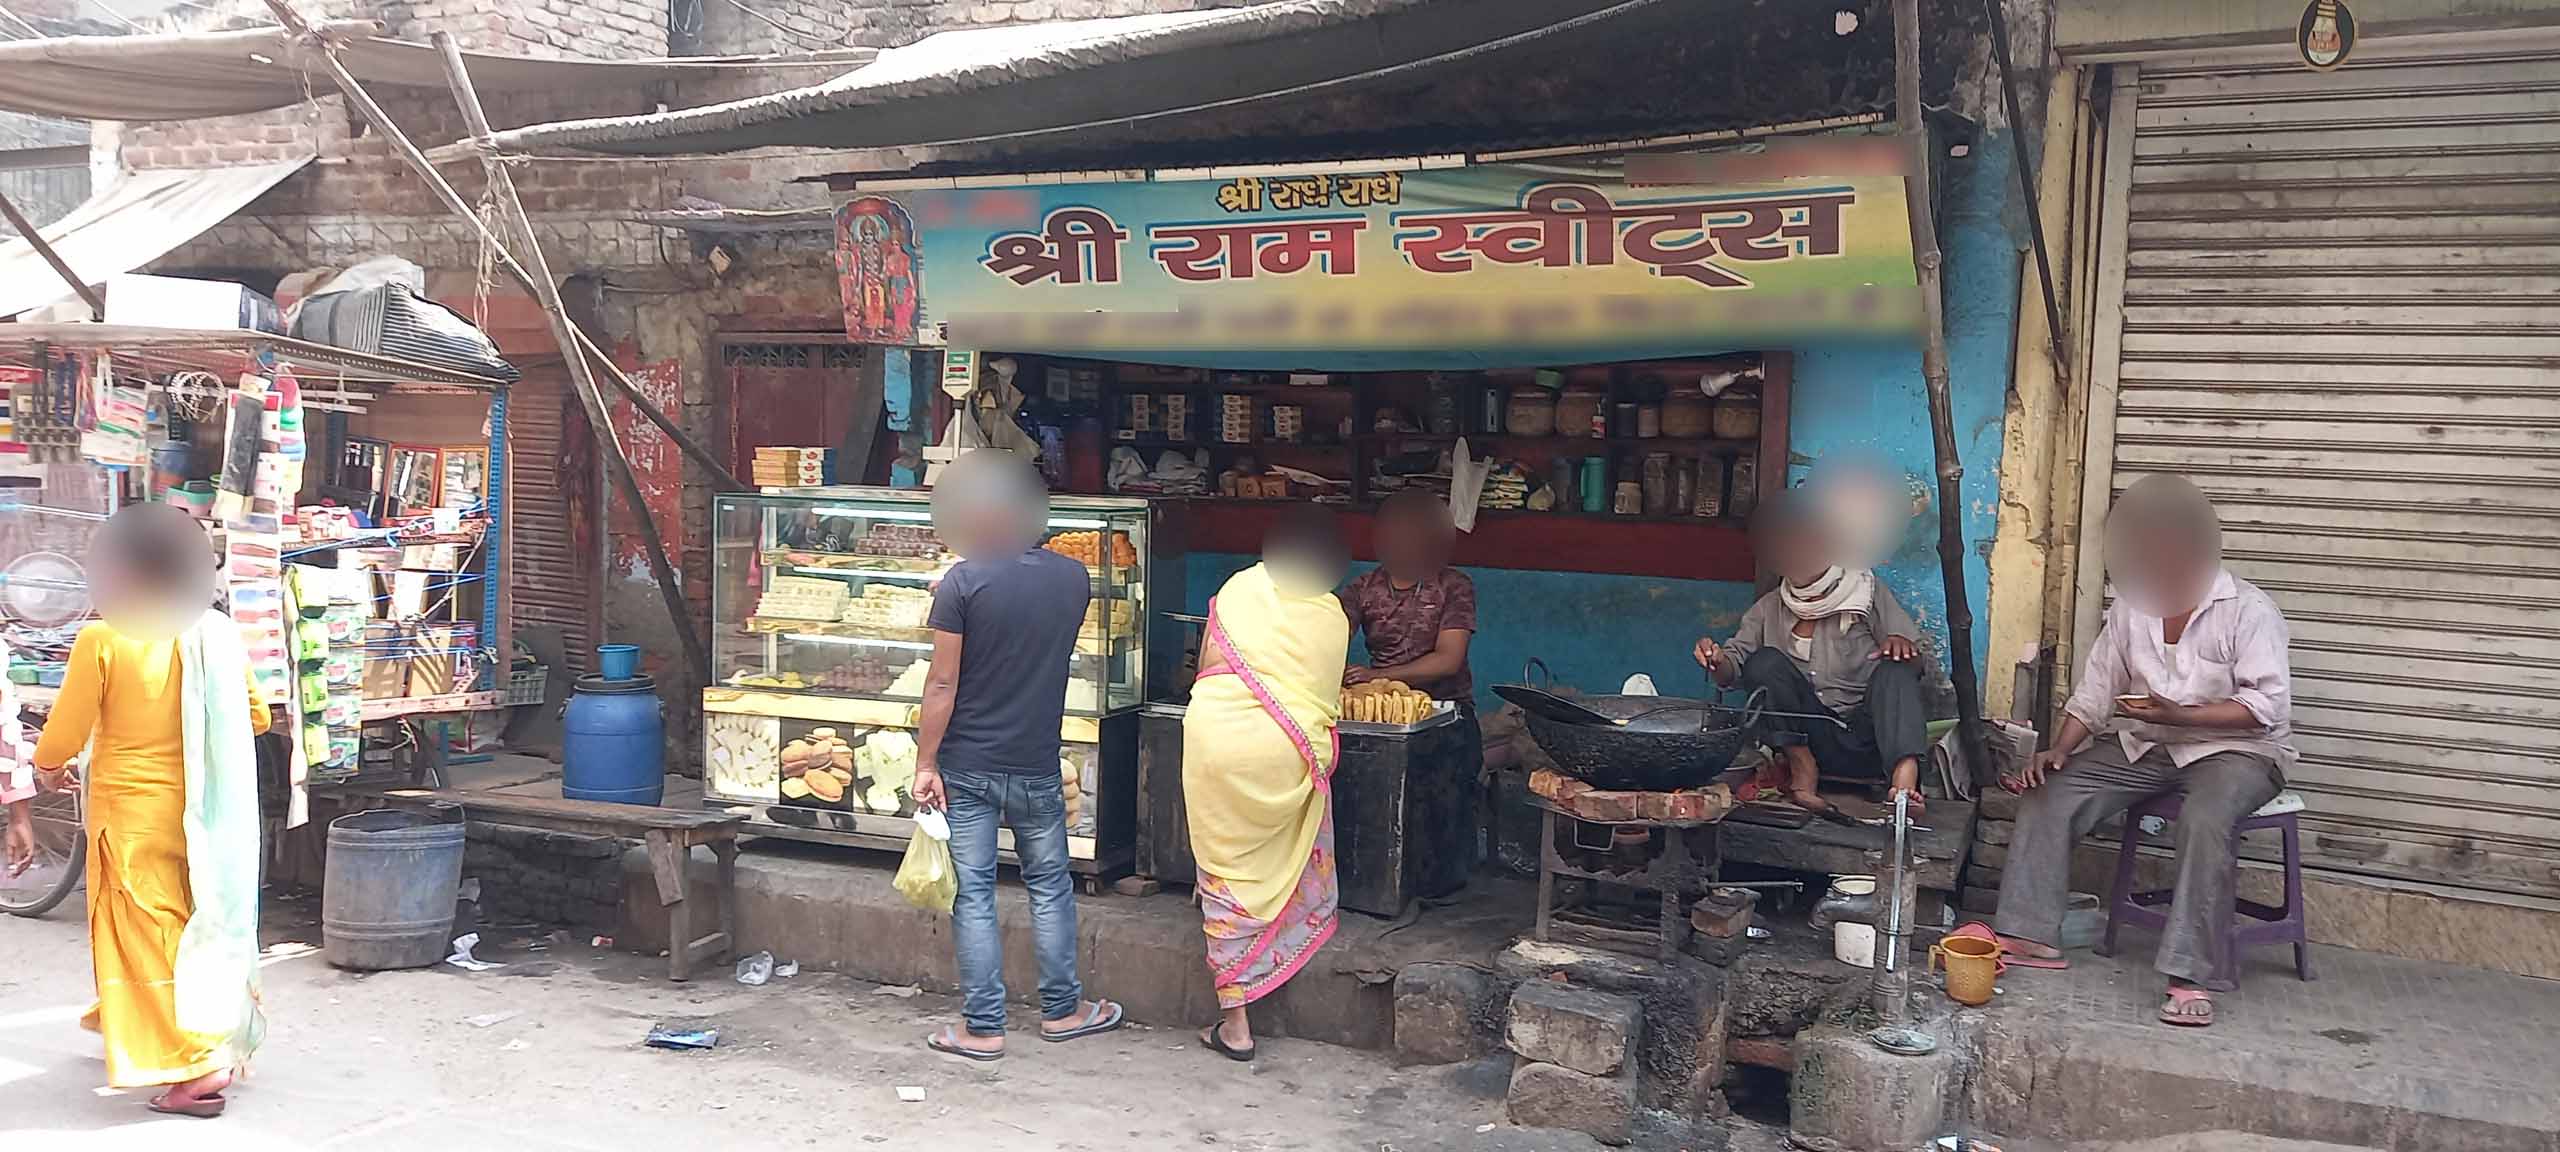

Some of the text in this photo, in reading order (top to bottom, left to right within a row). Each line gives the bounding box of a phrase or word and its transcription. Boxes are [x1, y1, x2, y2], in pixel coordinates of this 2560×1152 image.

[1217, 175, 1264, 212] श्री
[980, 206, 1131, 287] श्री
[1147, 213, 1368, 282] राम
[1390, 180, 1855, 288] स्वीट्स
